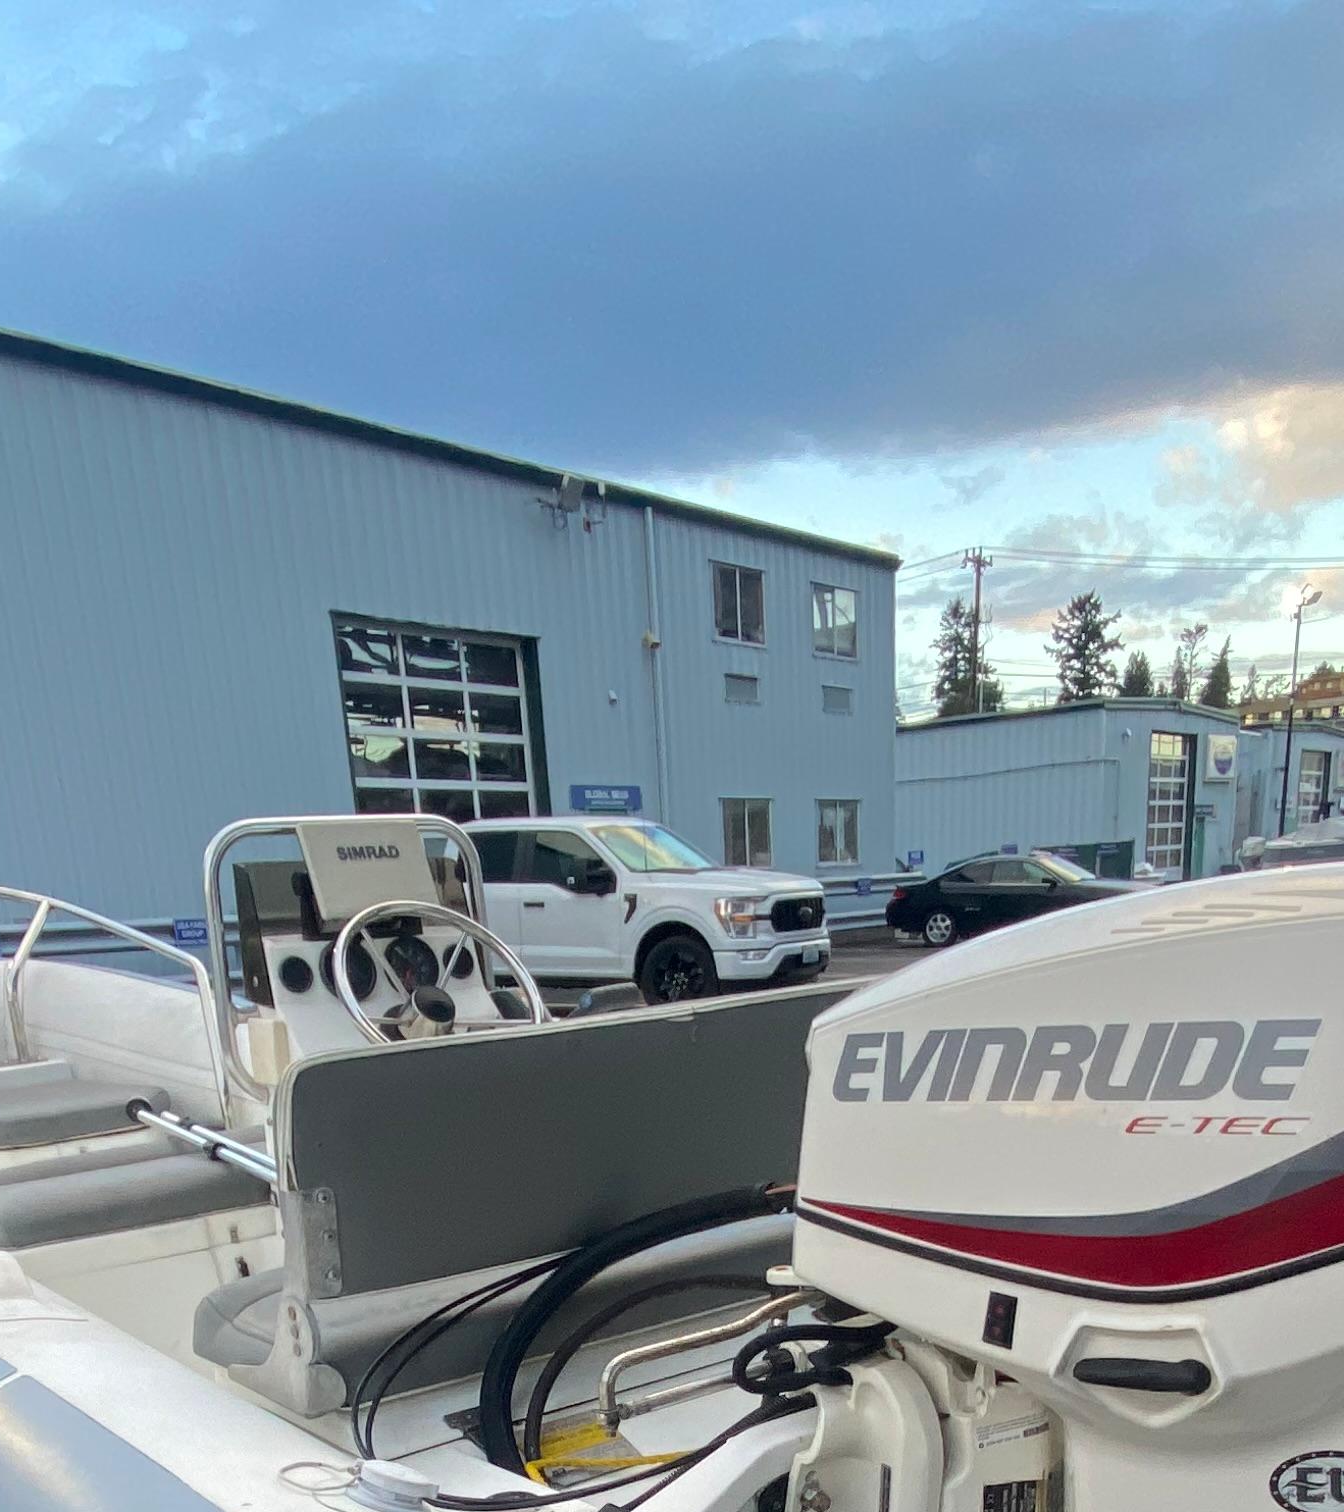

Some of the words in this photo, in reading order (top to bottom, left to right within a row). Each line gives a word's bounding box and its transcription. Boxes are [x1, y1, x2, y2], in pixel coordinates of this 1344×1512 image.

[336, 845, 400, 861] SIMRAD
[833, 1019, 1323, 1102] EVINRUDE
[1125, 1116, 1311, 1136] E-TEC
